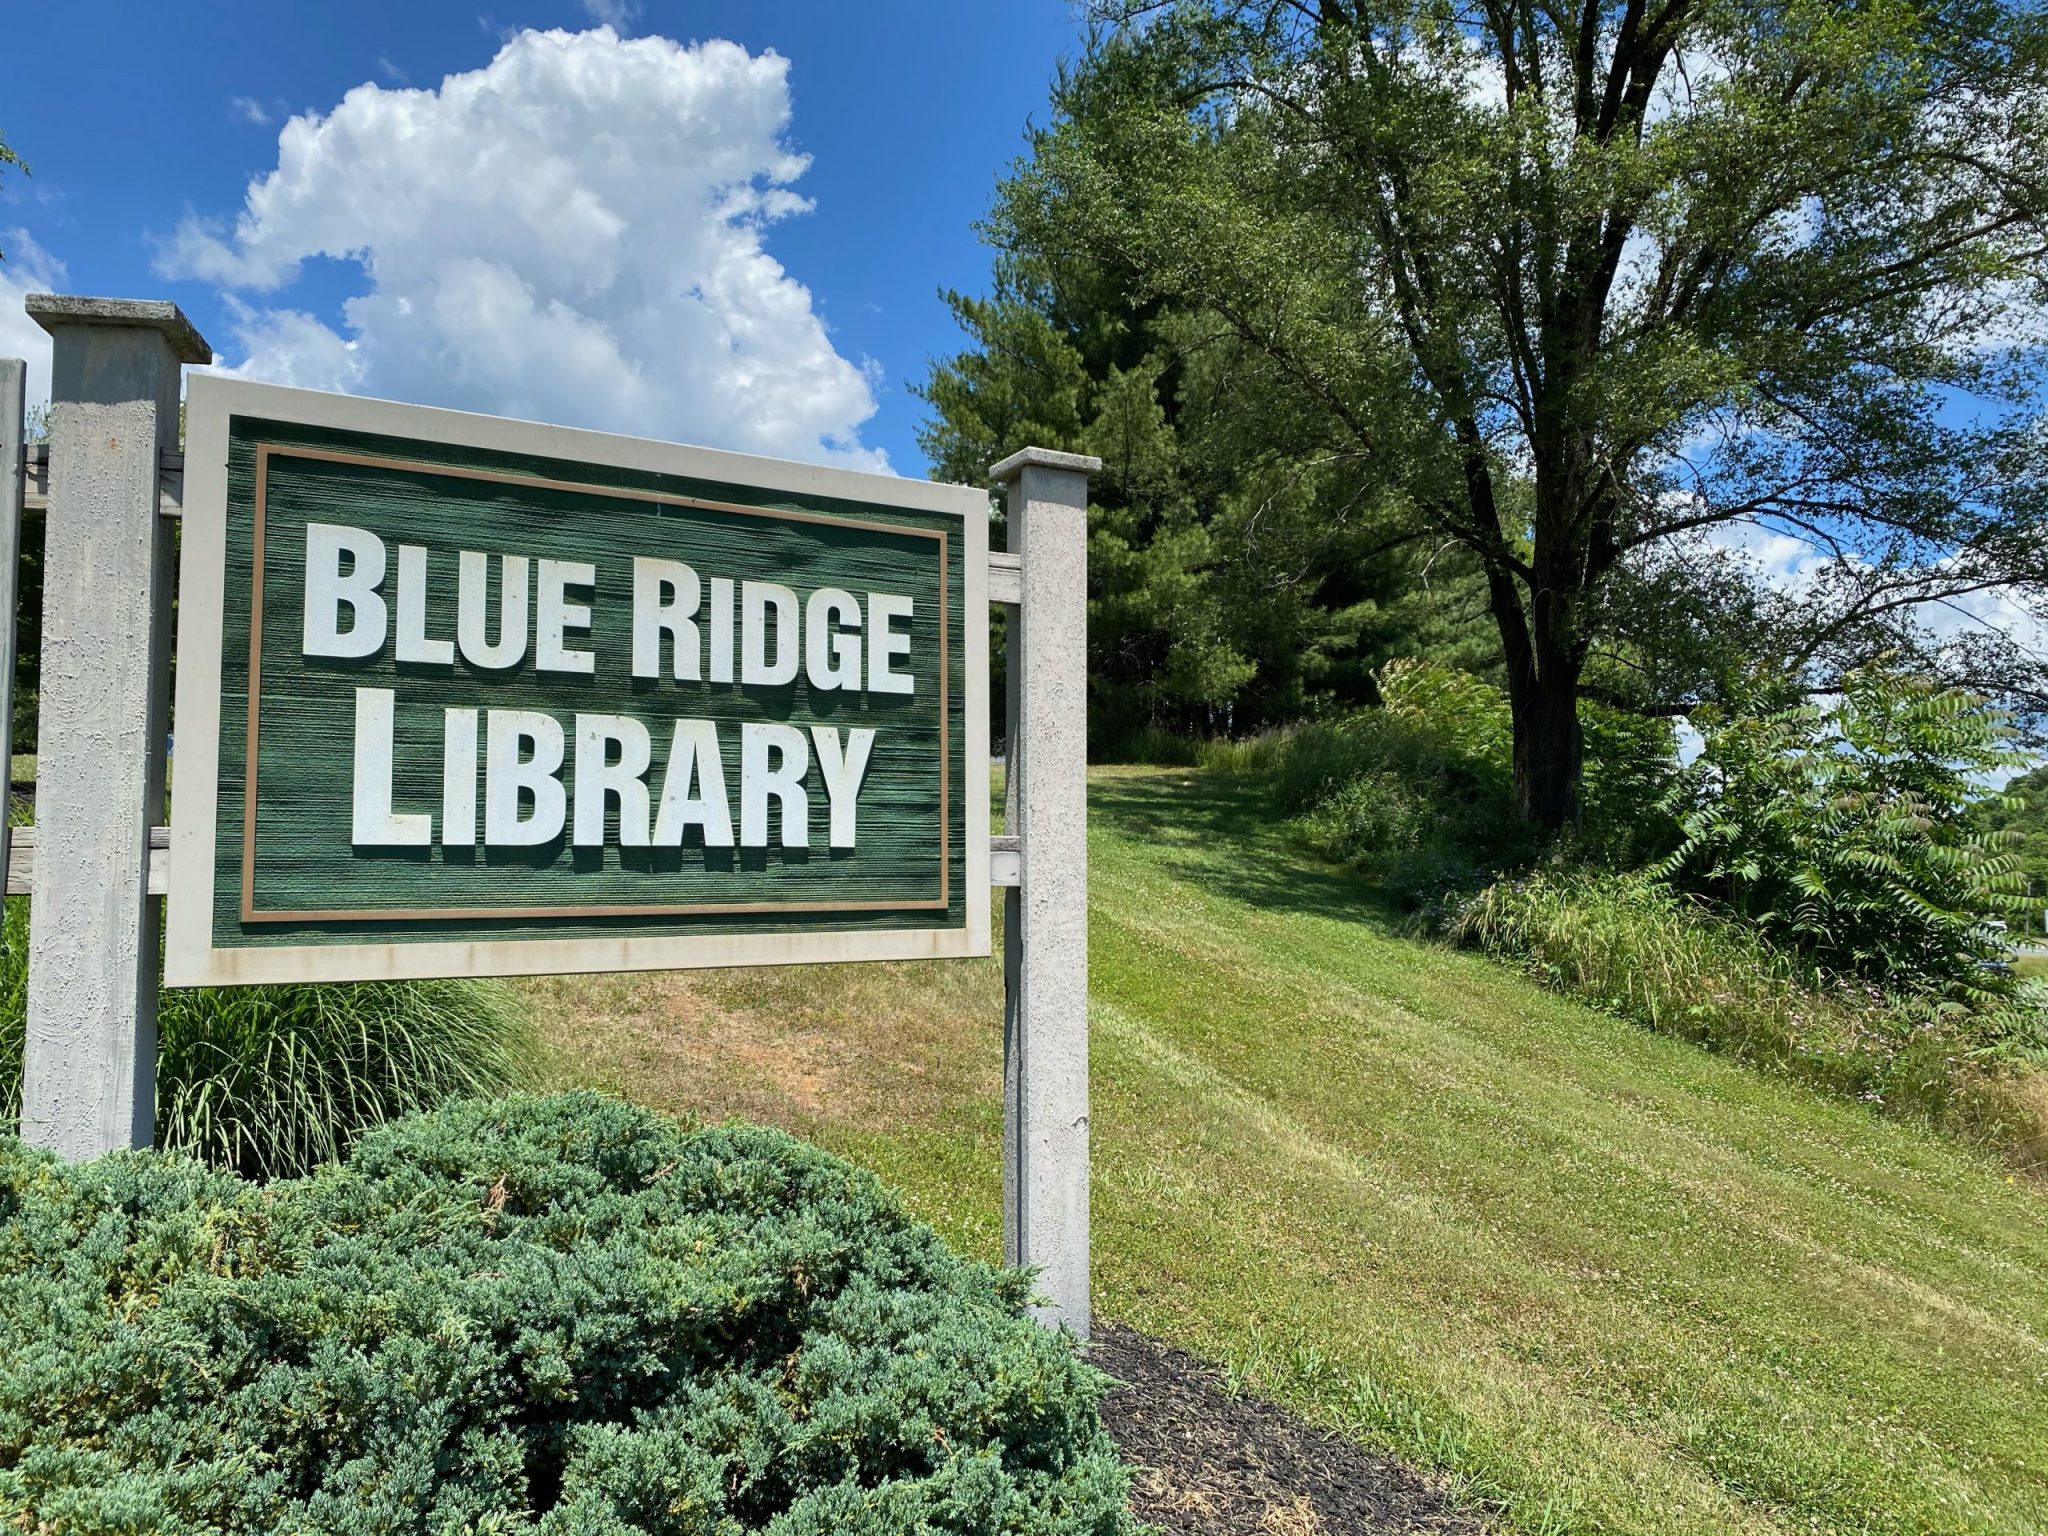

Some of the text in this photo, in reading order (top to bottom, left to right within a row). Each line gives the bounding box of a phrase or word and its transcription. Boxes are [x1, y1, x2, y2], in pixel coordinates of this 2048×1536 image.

[303, 523, 915, 695] BLUE RIDGE
[351, 687, 876, 848] LIBRARY
